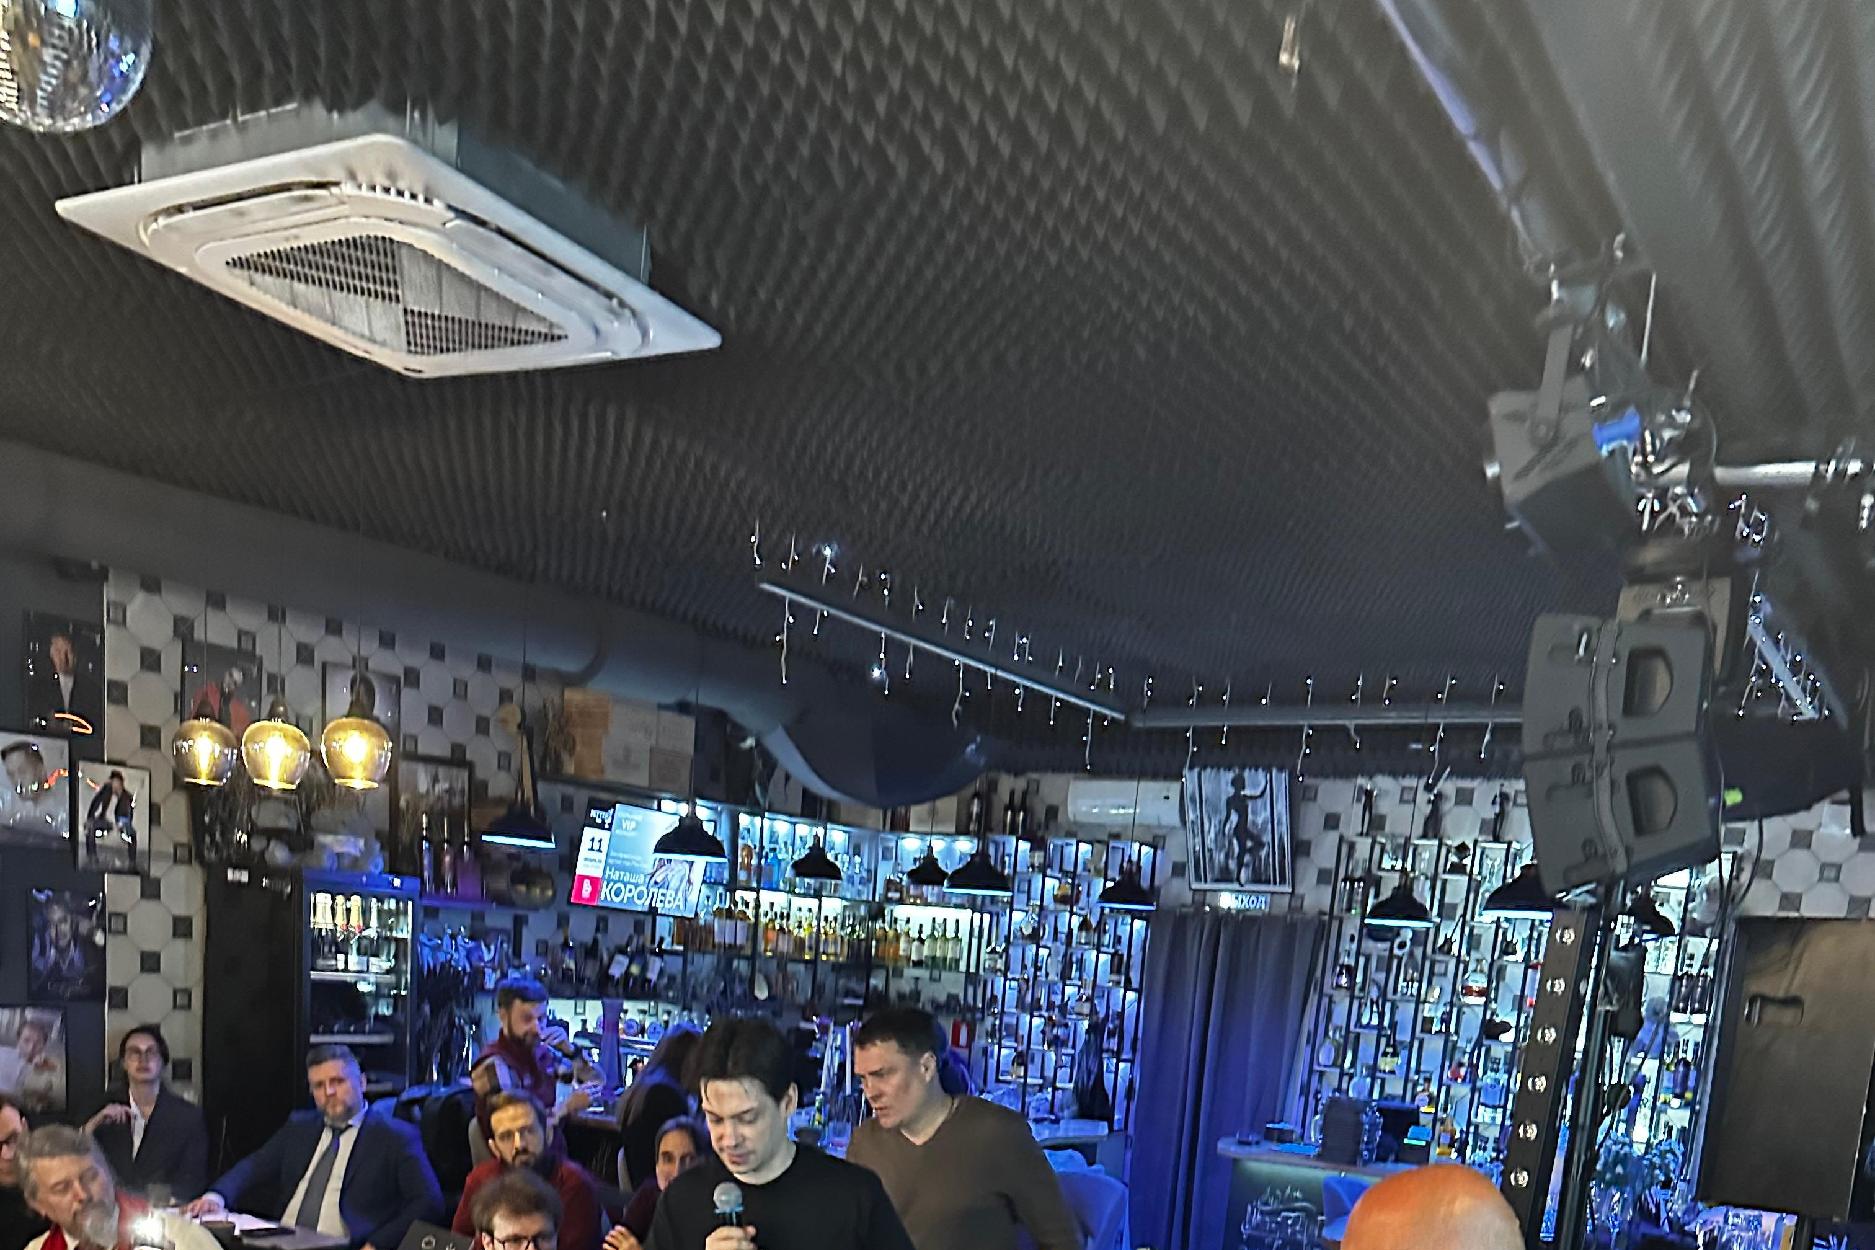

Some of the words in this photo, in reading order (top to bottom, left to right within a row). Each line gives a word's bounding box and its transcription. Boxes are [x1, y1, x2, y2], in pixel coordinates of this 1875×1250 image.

[587, 836, 603, 853] 11
[605, 866, 645, 884] Наташа
[600, 879, 684, 910] КОРОЛЕВА
[1222, 893, 1266, 910] ЫХОД
